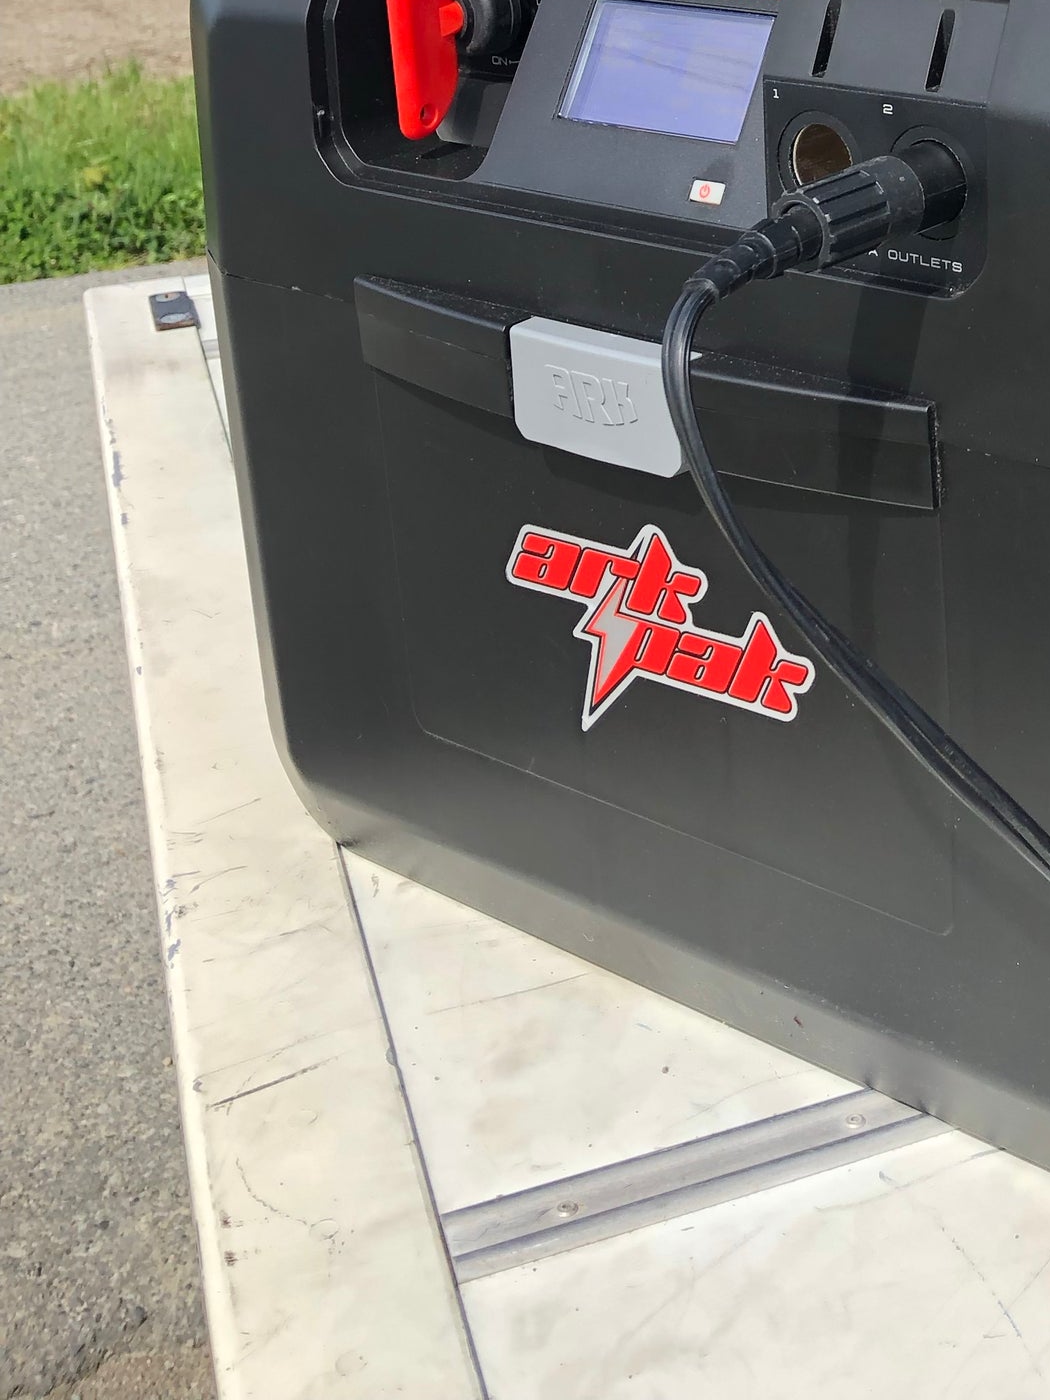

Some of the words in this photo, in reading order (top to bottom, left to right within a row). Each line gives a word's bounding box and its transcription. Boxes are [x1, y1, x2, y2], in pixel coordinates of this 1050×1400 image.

[491, 55, 508, 66] ON
[772, 88, 780, 99] 1
[882, 103, 894, 115] 2
[887, 249, 963, 273] OUTLETS
[543, 363, 639, 427] ARK
[511, 532, 703, 625] ark
[593, 619, 810, 715] pak
